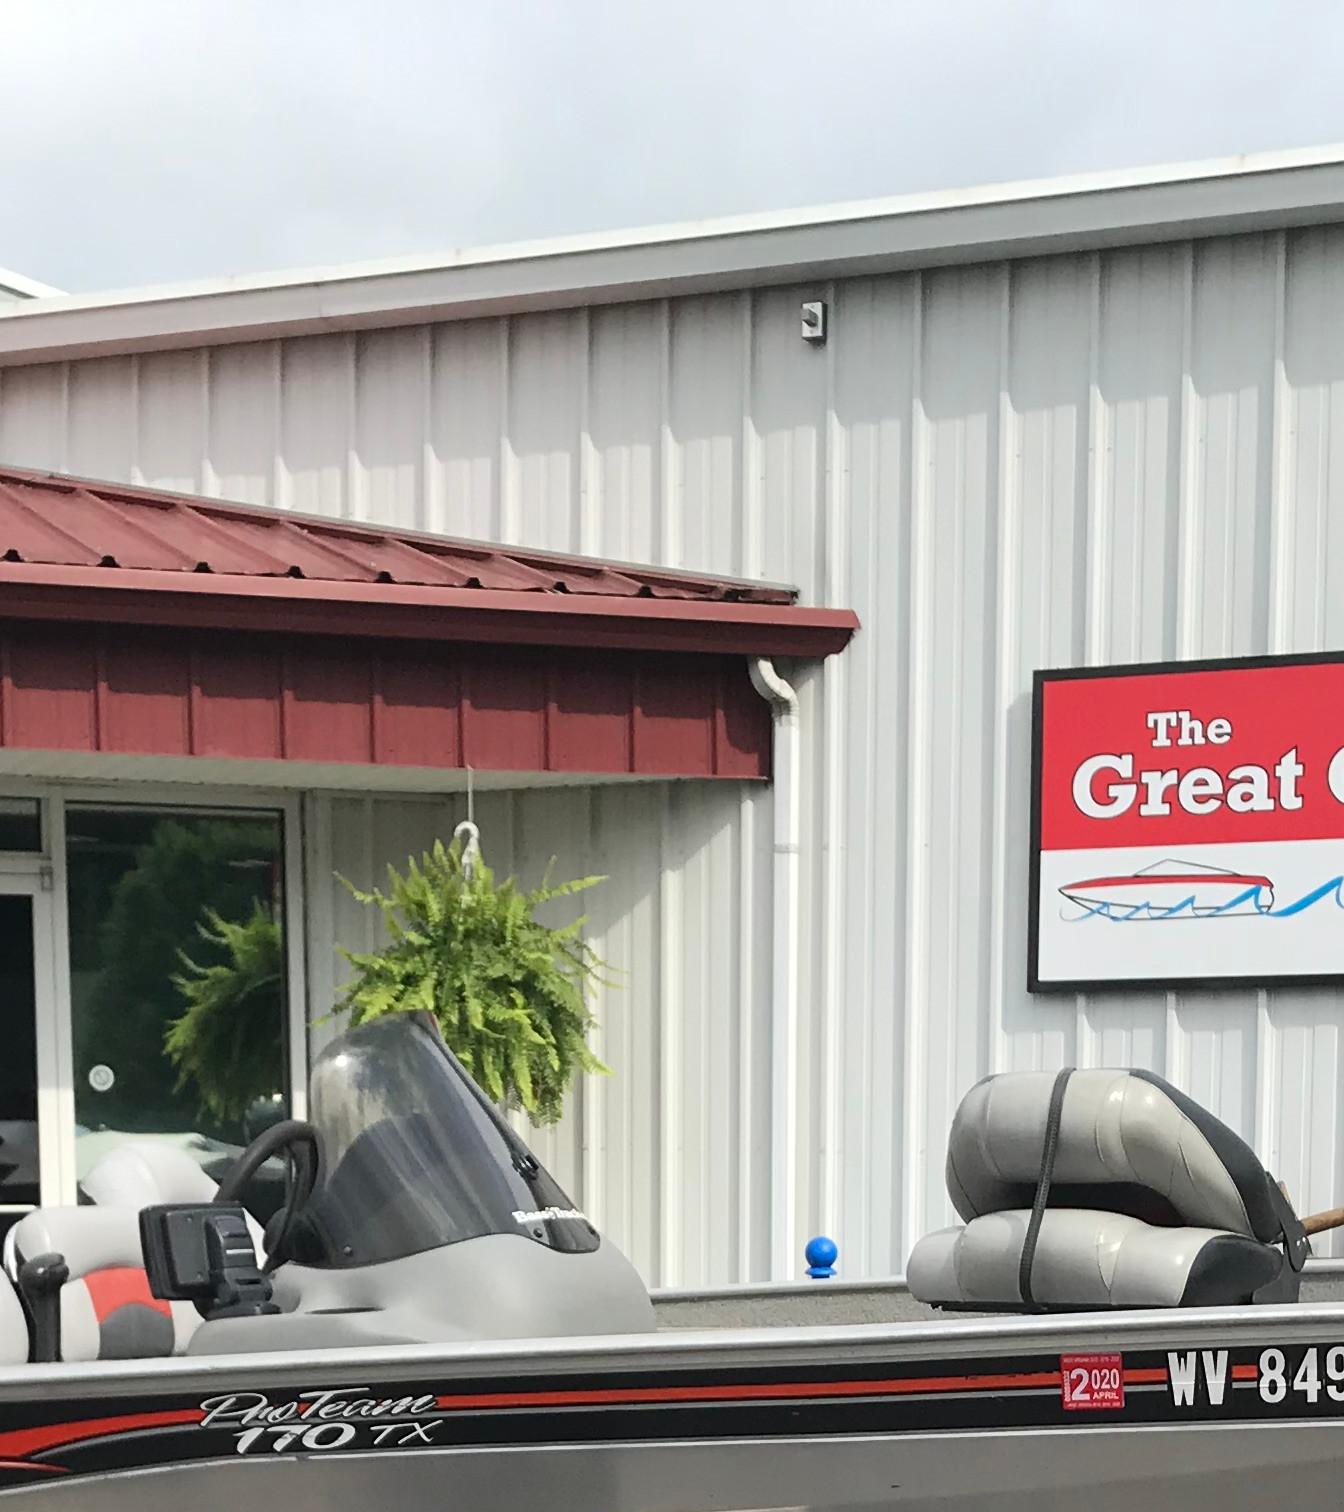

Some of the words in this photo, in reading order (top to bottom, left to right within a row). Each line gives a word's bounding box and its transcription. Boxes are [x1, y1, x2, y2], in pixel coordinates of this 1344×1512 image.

[1146, 711, 1232, 747] The
[1071, 746, 1304, 820] Great
[1092, 1391, 1120, 1401] APRIL
[1167, 1350, 1229, 1406] WV
[232, 1422, 356, 1454] 170
[369, 1419, 444, 1445] TX
